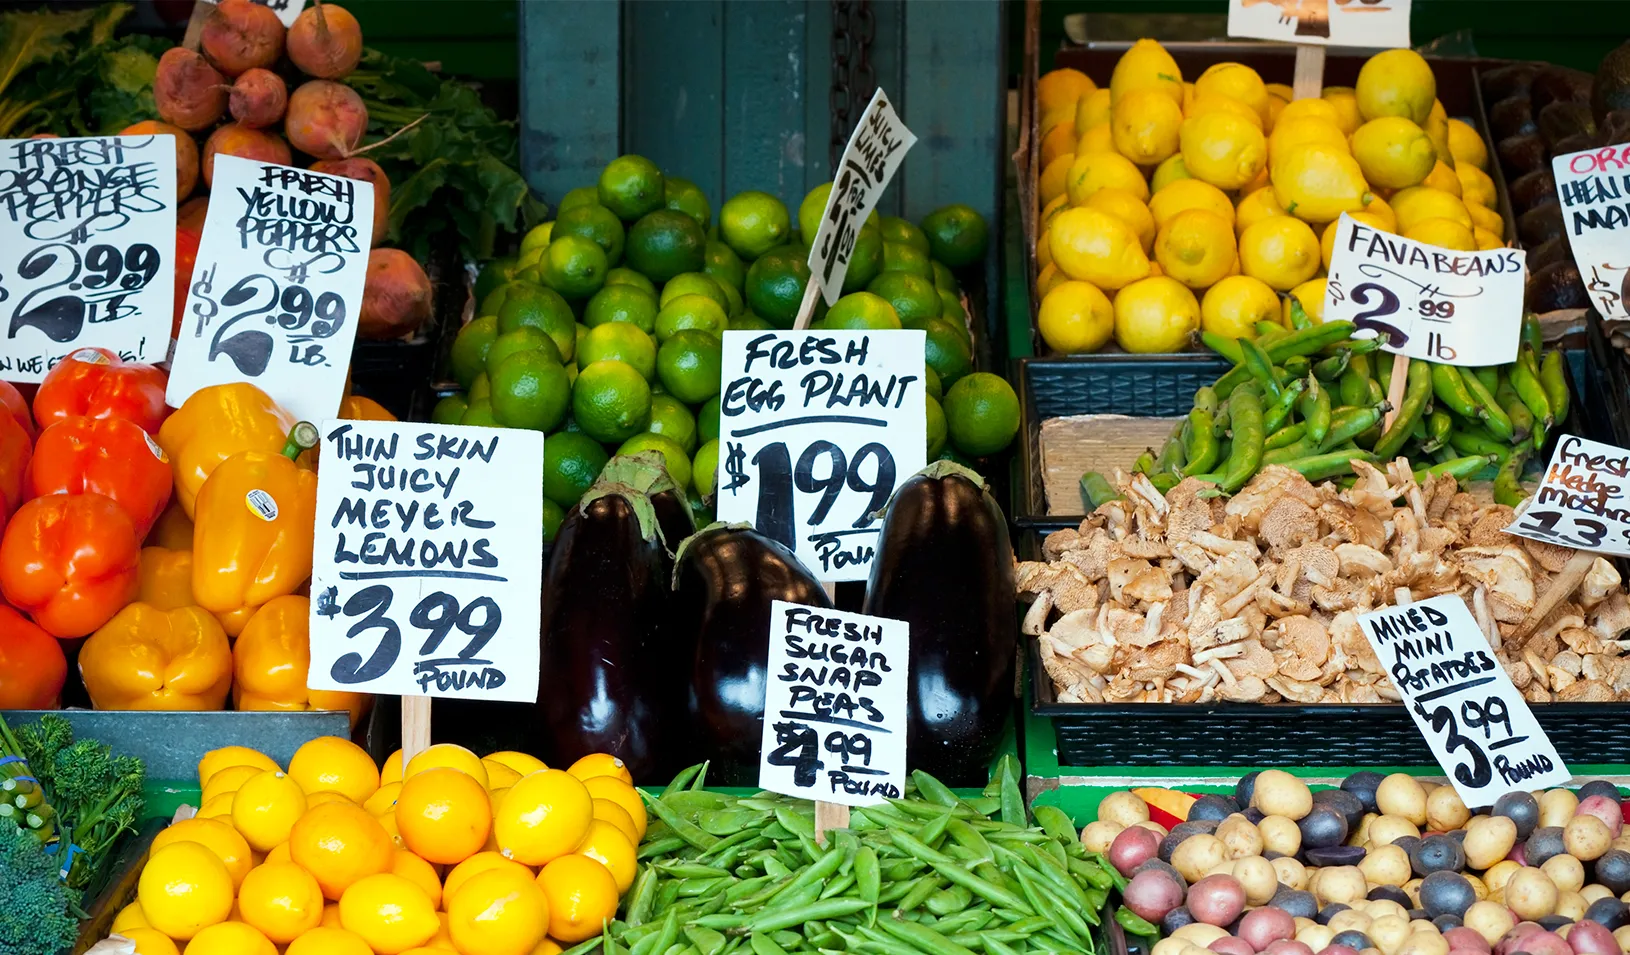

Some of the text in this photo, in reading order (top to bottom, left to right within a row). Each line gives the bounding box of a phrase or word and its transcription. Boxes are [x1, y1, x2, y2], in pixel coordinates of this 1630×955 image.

[9, 136, 155, 169] FRESH
[0, 162, 158, 195] ORANGE
[258, 166, 354, 203] FRESH
[236, 186, 354, 224] YELLOW
[236, 216, 361, 253] PEPPERS
[744, 333, 870, 373] FRESH
[1427, 332, 1457, 361] lb
[16, 356, 43, 374] WE
[722, 369, 918, 417] EGG PLANT
[327, 424, 499, 463] THIN SKIN
[351, 463, 460, 499] JUICY
[331, 497, 496, 533] MEYER
[334, 532, 499, 568] LEMONS
[785, 608, 883, 645] FRESH
[1369, 606, 1448, 645] MIXED
[785, 635, 892, 672] SUGAR
[1393, 631, 1454, 663] MINI
[413, 663, 506, 694] POUND
[777, 662, 882, 693] SNAP
[1391, 650, 1496, 694] POTATOES
[789, 685, 884, 722] PEAS
[828, 770, 900, 798] POUND
[1492, 753, 1554, 787] POUND
